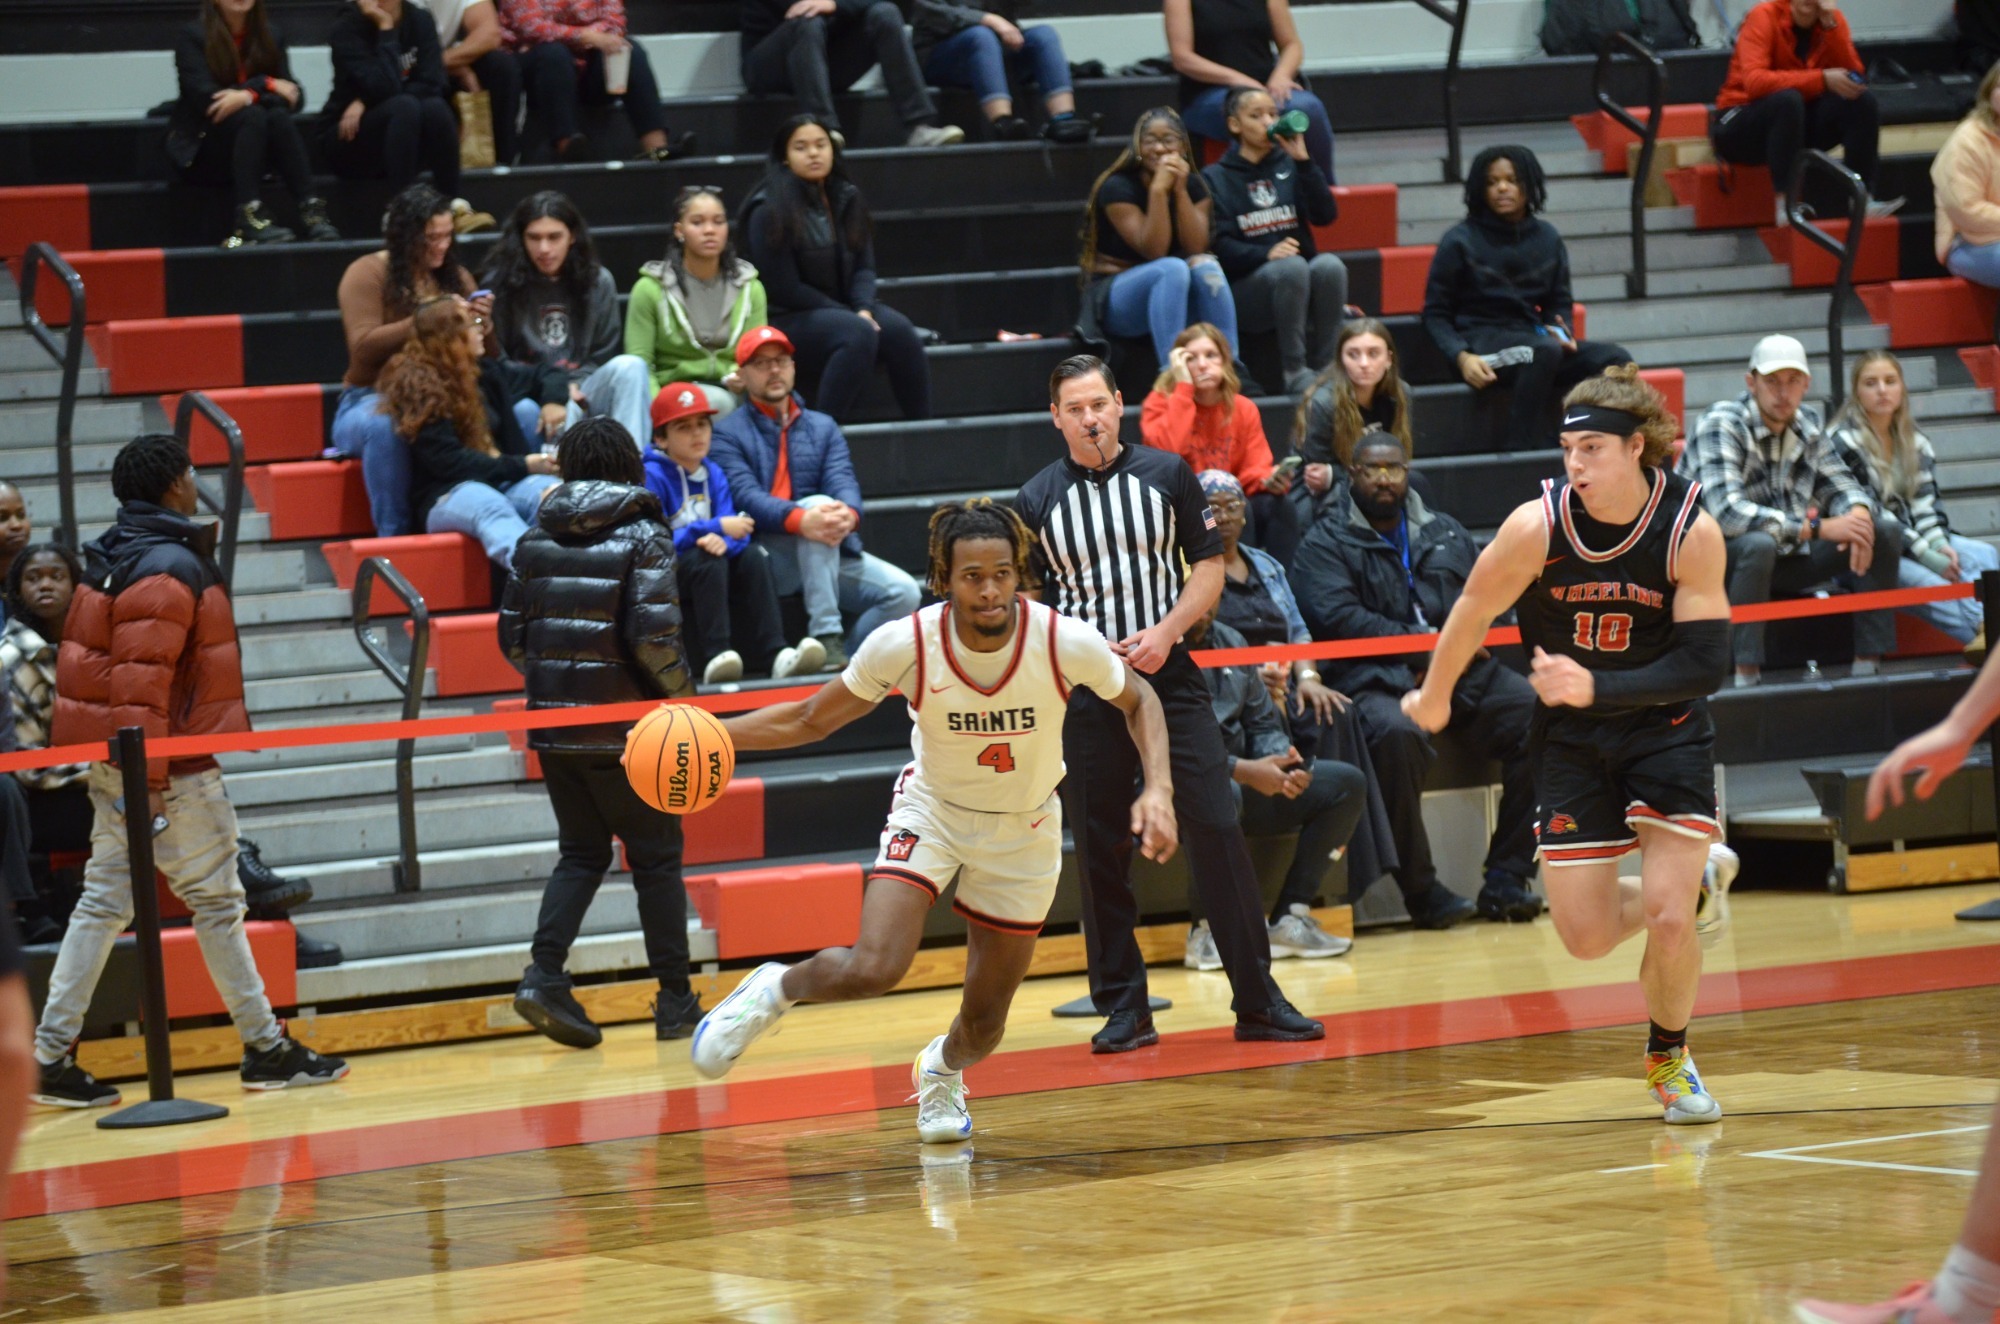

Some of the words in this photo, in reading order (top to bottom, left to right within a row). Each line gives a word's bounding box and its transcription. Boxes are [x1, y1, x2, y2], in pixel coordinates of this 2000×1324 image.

[1573, 611, 1633, 652] 10
[668, 741, 690, 808] Wilson
[706, 750, 721, 799] NCAA
[977, 742, 1015, 774] 4
